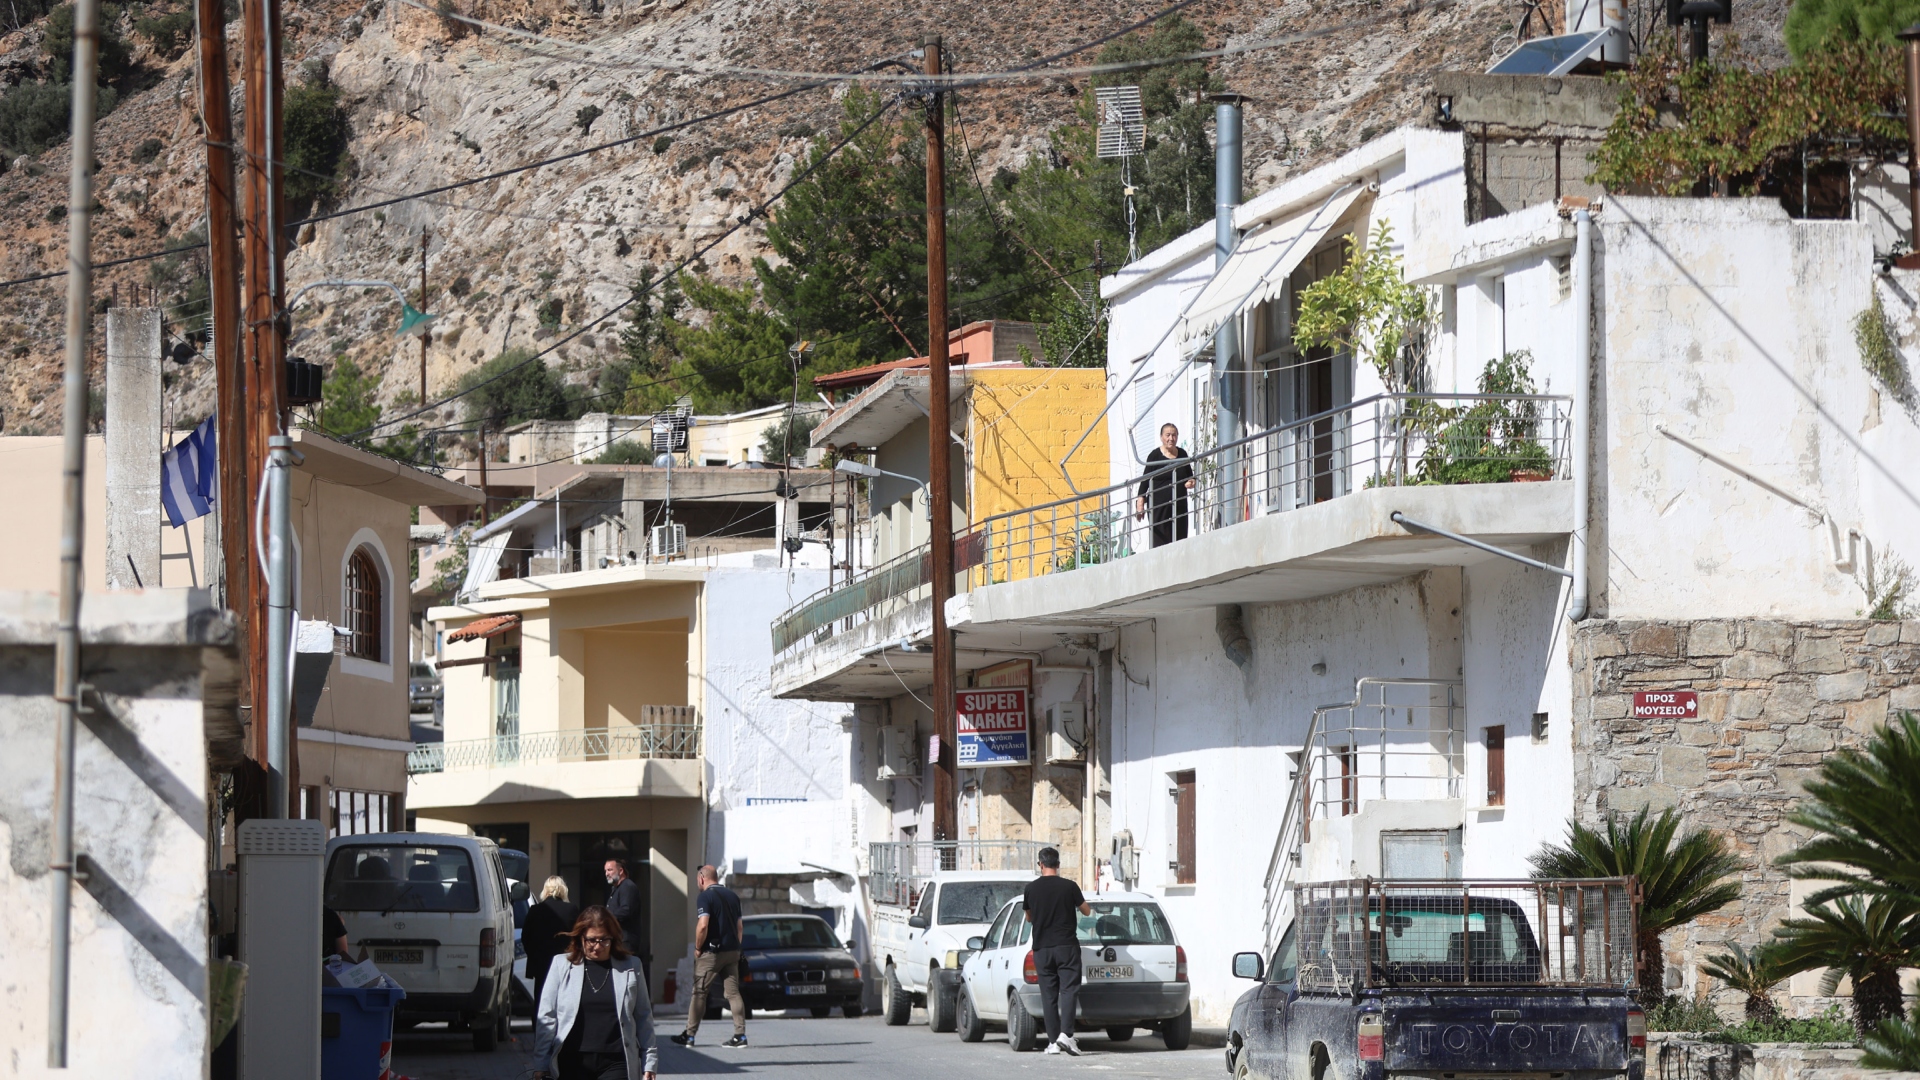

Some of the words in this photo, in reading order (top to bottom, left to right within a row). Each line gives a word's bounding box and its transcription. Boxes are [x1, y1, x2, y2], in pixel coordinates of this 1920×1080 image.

[964, 693, 1018, 712] SUPER
[1645, 694, 1675, 703] ΠΡΟΣ
[1635, 706, 1685, 715] ΜΟΥΣΕΙΟ
[959, 711, 1024, 731] MARKET
[991, 742, 1025, 751] Αγγελική
[398, 951, 422, 962] 5353
[1088, 967, 1106, 978] KME
[1109, 966, 1133, 977] 9940
[1412, 1024, 1601, 1055] TOYOTA
